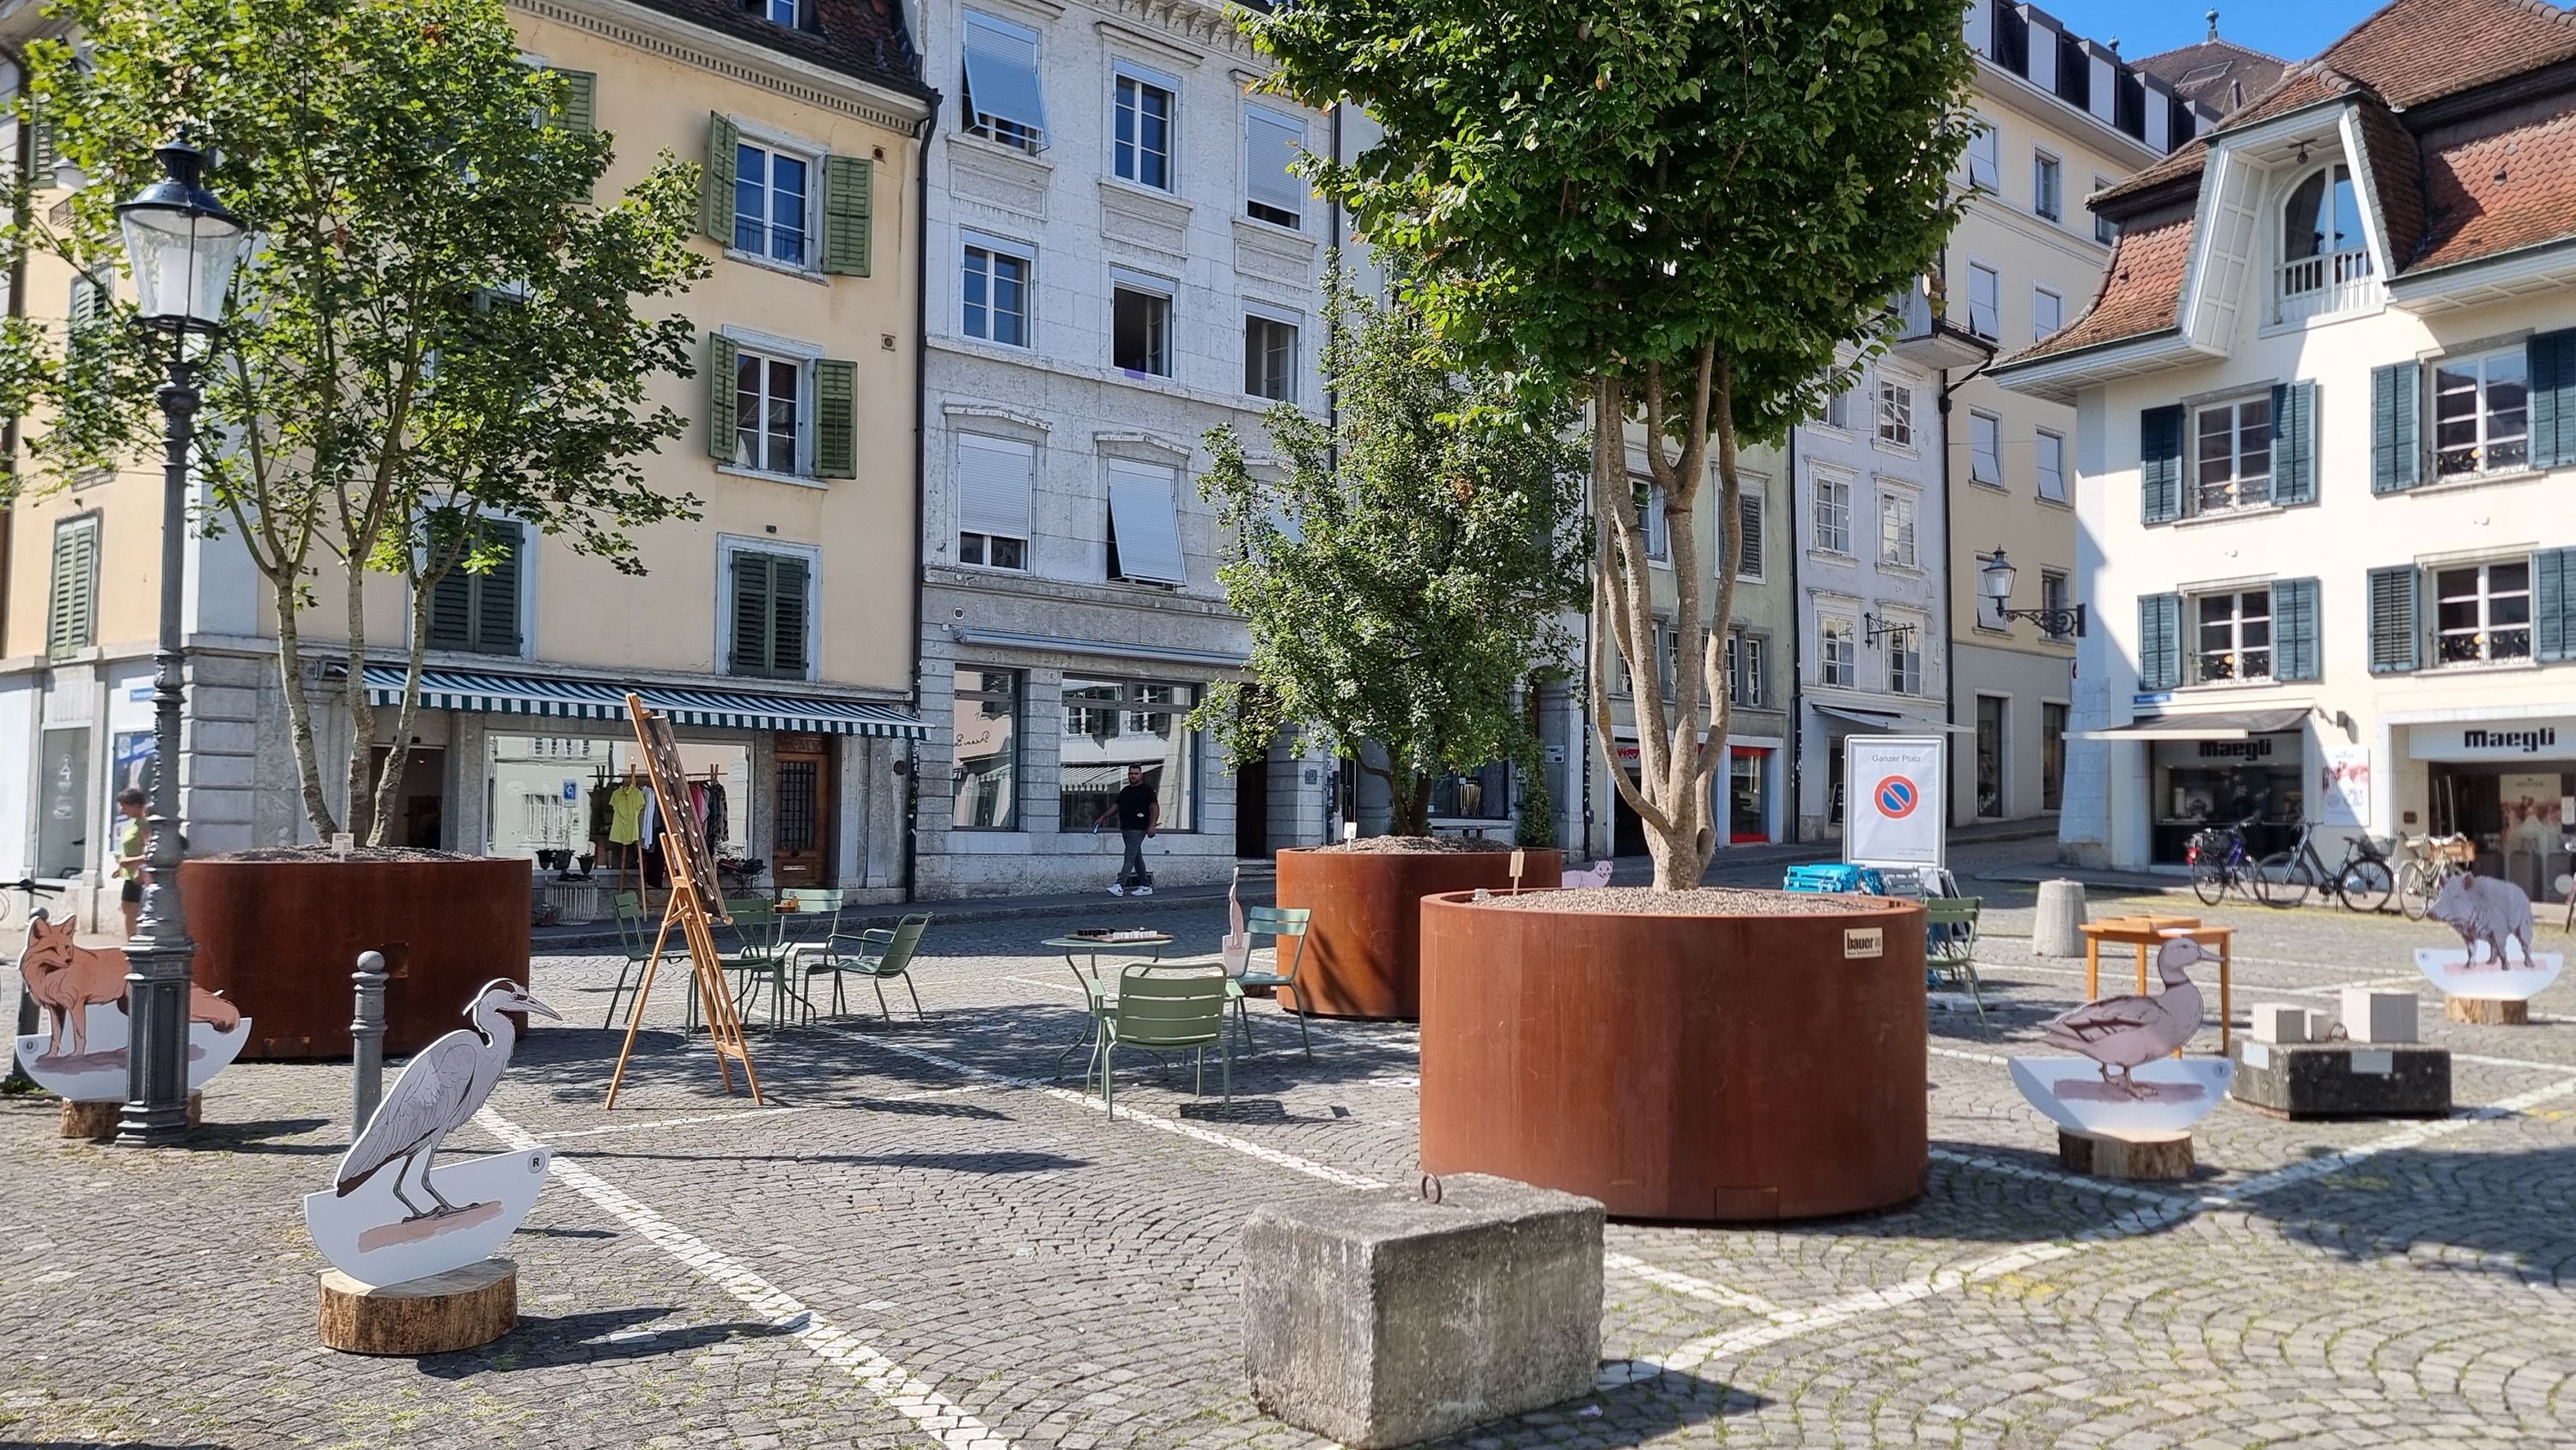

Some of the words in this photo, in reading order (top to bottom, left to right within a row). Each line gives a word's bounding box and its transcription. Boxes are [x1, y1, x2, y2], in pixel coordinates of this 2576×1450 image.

[1872, 755, 1899, 763] Ganzer
[1902, 755, 1922, 763] Platz
[1847, 932, 1874, 949] bauer
[532, 1157, 539, 1168] R
